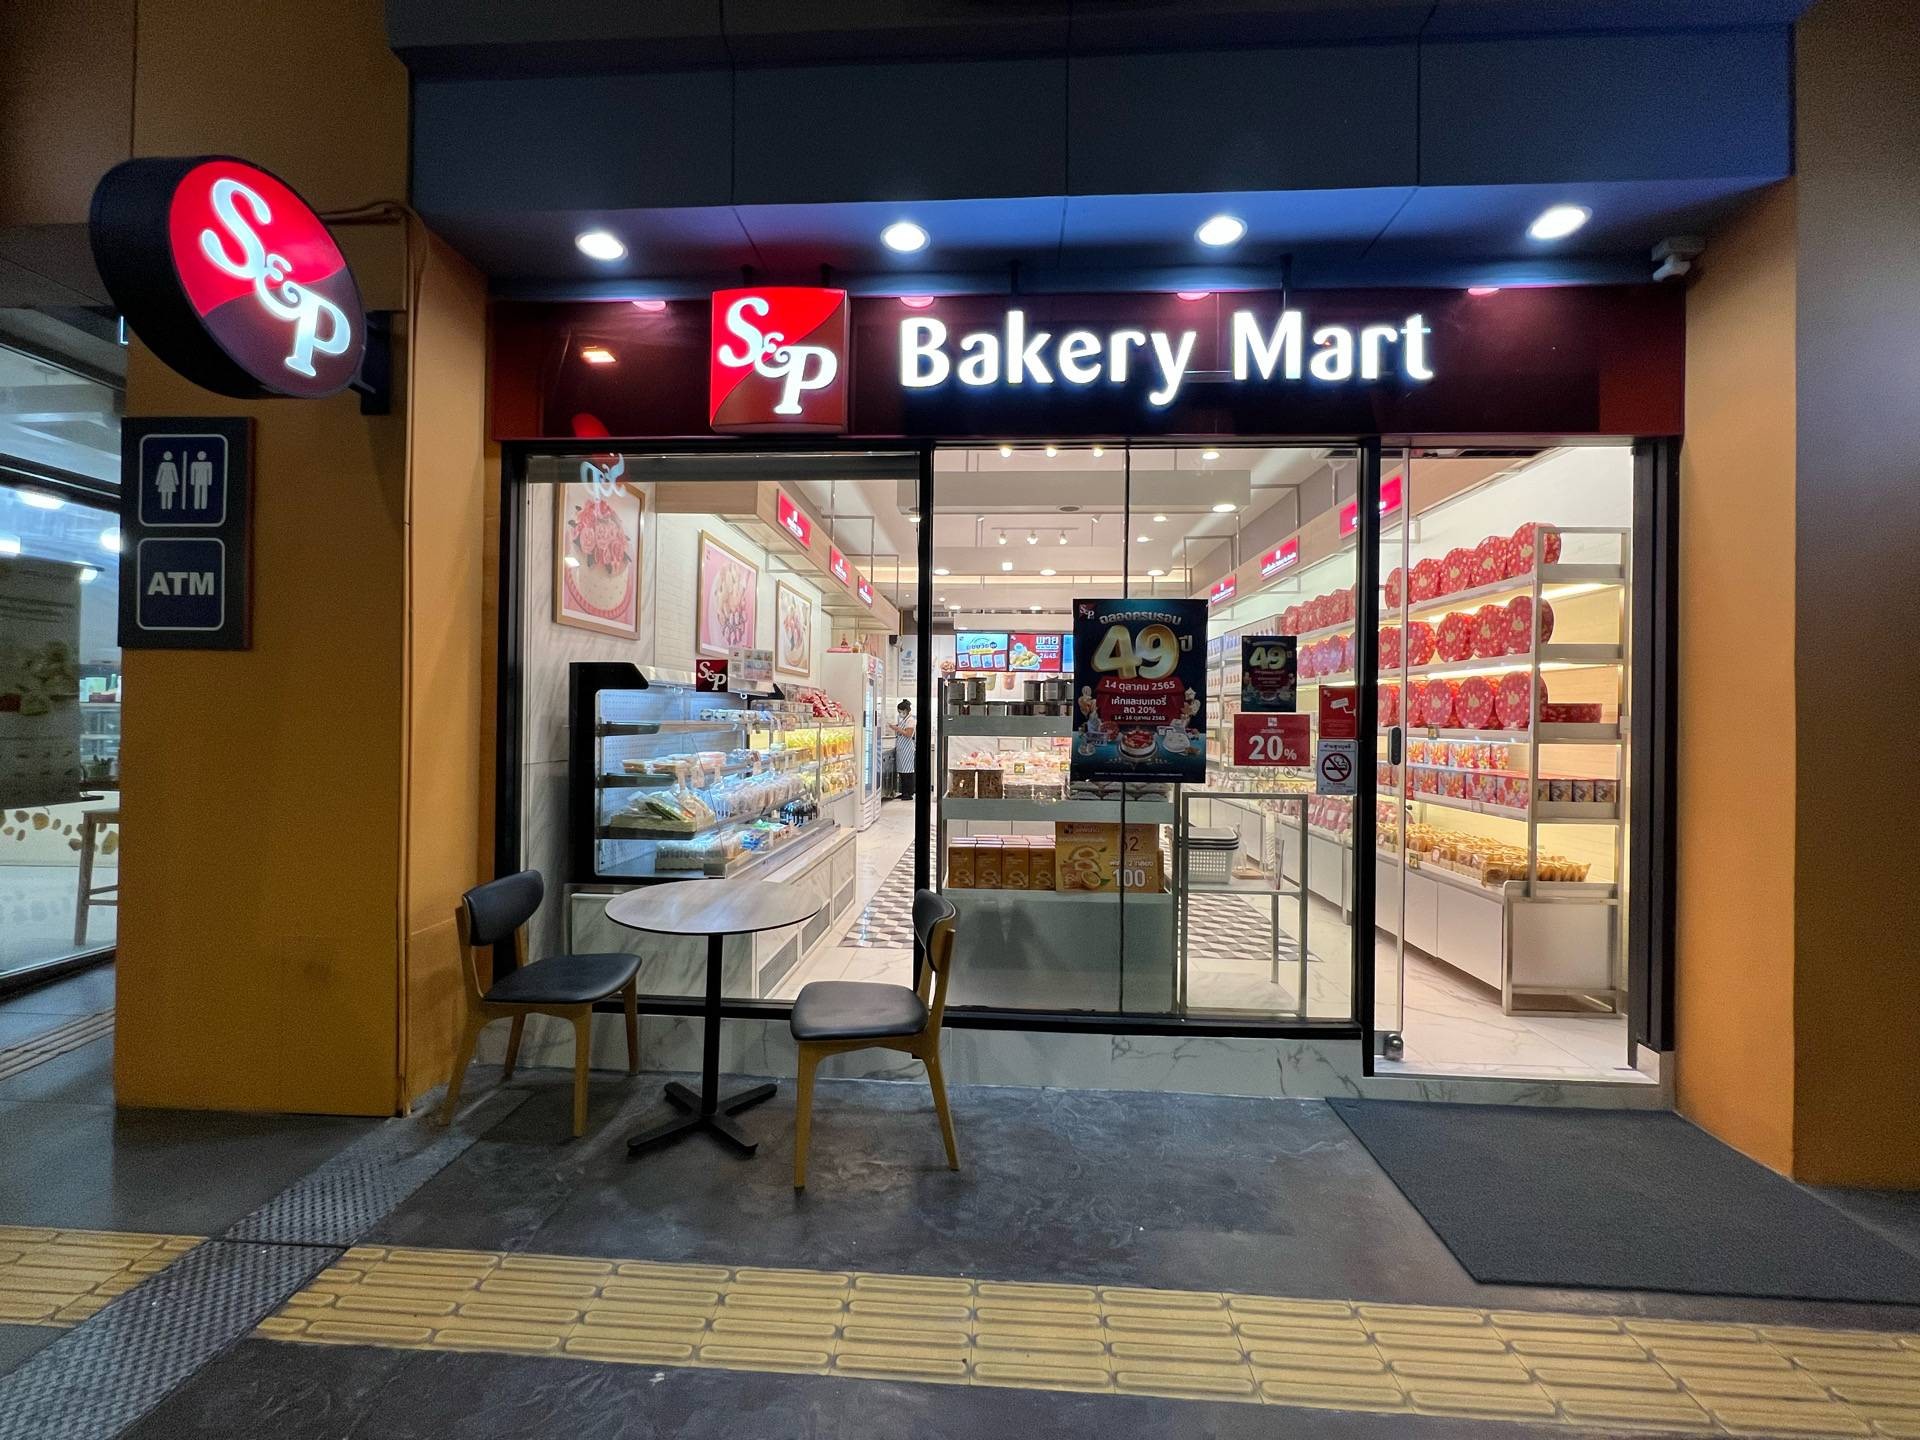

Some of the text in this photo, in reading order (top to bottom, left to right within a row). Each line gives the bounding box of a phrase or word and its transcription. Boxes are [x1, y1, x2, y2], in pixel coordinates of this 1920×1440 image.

[200, 177, 352, 377] S&P
[718, 297, 838, 415] S&P
[901, 310, 1434, 406] Bakery Mart
[147, 571, 215, 596] ATM
[1092, 624, 1180, 679] 49
[1250, 646, 1286, 669] 49
[697, 661, 727, 691] S&P
[1104, 680, 1176, 692] 14 ตุลาคม 2565
[1137, 706, 1157, 714] 20%
[1248, 735, 1298, 761] 20%
